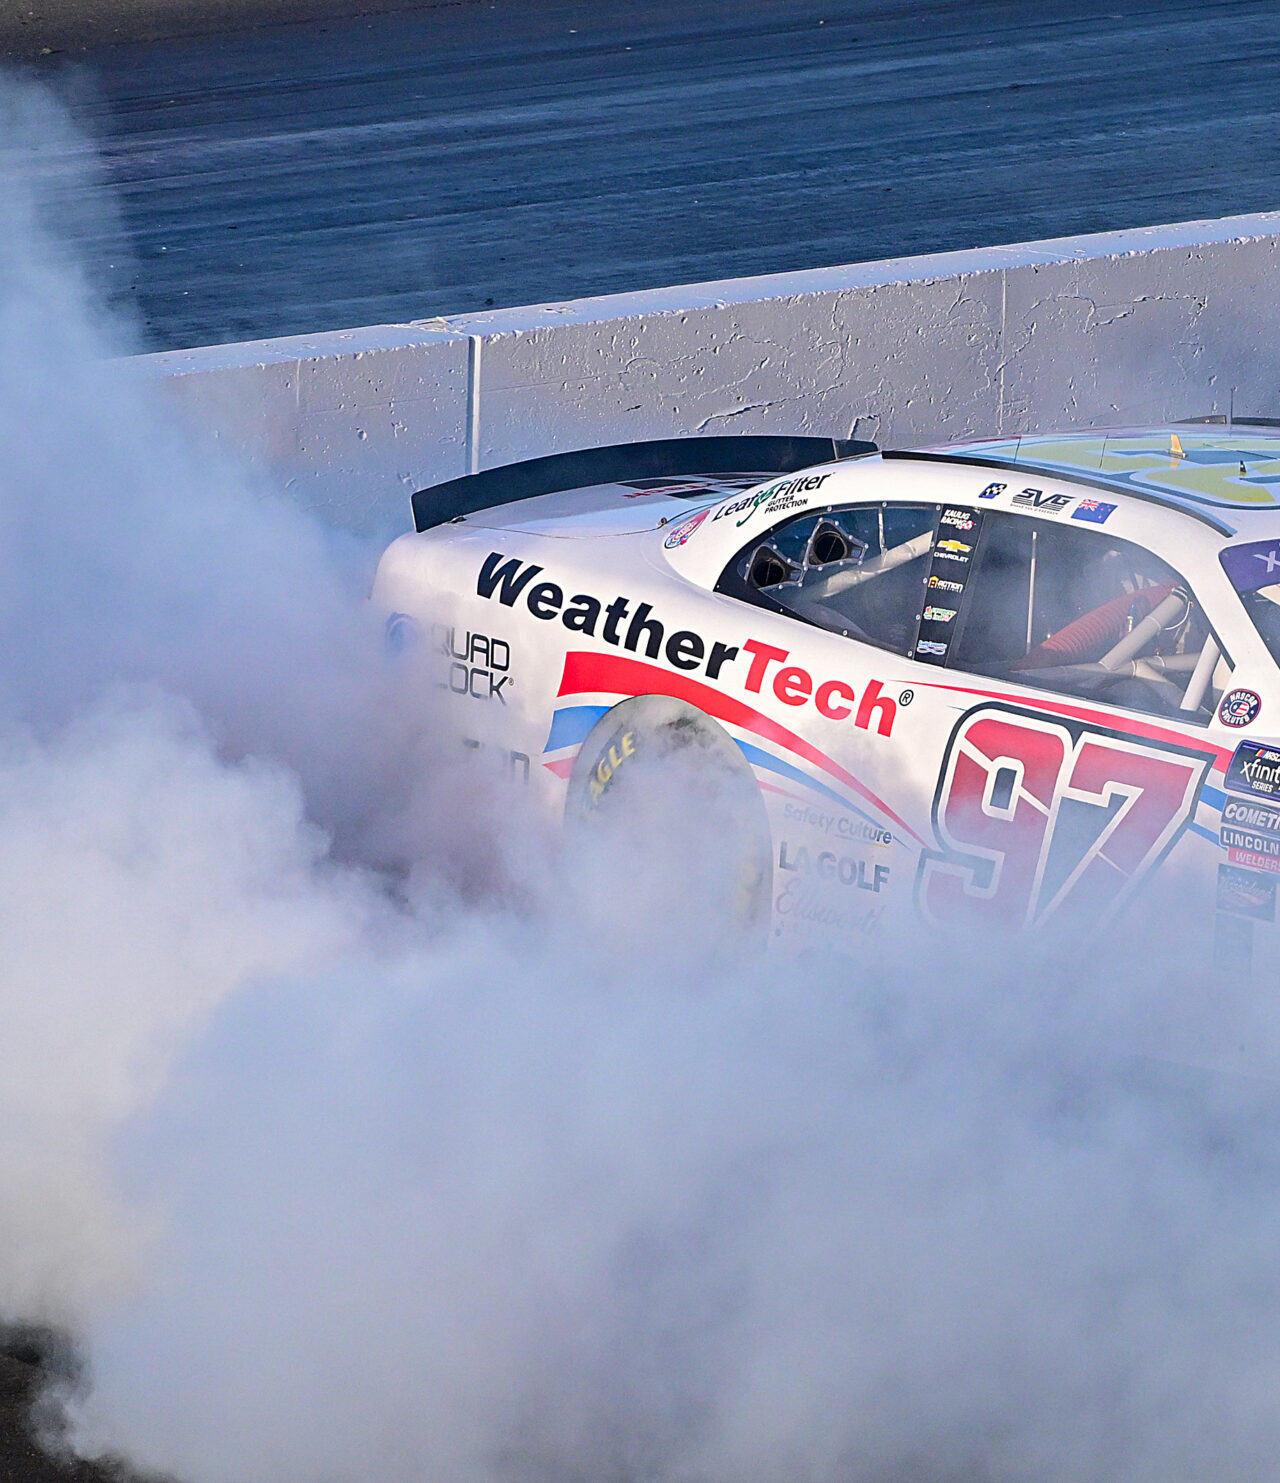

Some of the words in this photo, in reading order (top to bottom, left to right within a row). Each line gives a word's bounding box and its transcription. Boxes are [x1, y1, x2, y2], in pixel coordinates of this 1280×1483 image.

[764, 498, 809, 514] PROTECTION
[767, 495, 795, 507] GUTTER
[1013, 487, 1076, 507] SVG
[934, 551, 969, 563] CHEVROLET
[1230, 691, 1258, 708] NASCAR
[589, 731, 636, 806] AGLE
[1251, 781, 1274, 793] SERIES
[783, 803, 836, 833] Safety
[837, 817, 893, 845] Culture
[911, 701, 1217, 936] 97
[1223, 830, 1279, 856] LINCOLN
[816, 851, 891, 893] GOLF
